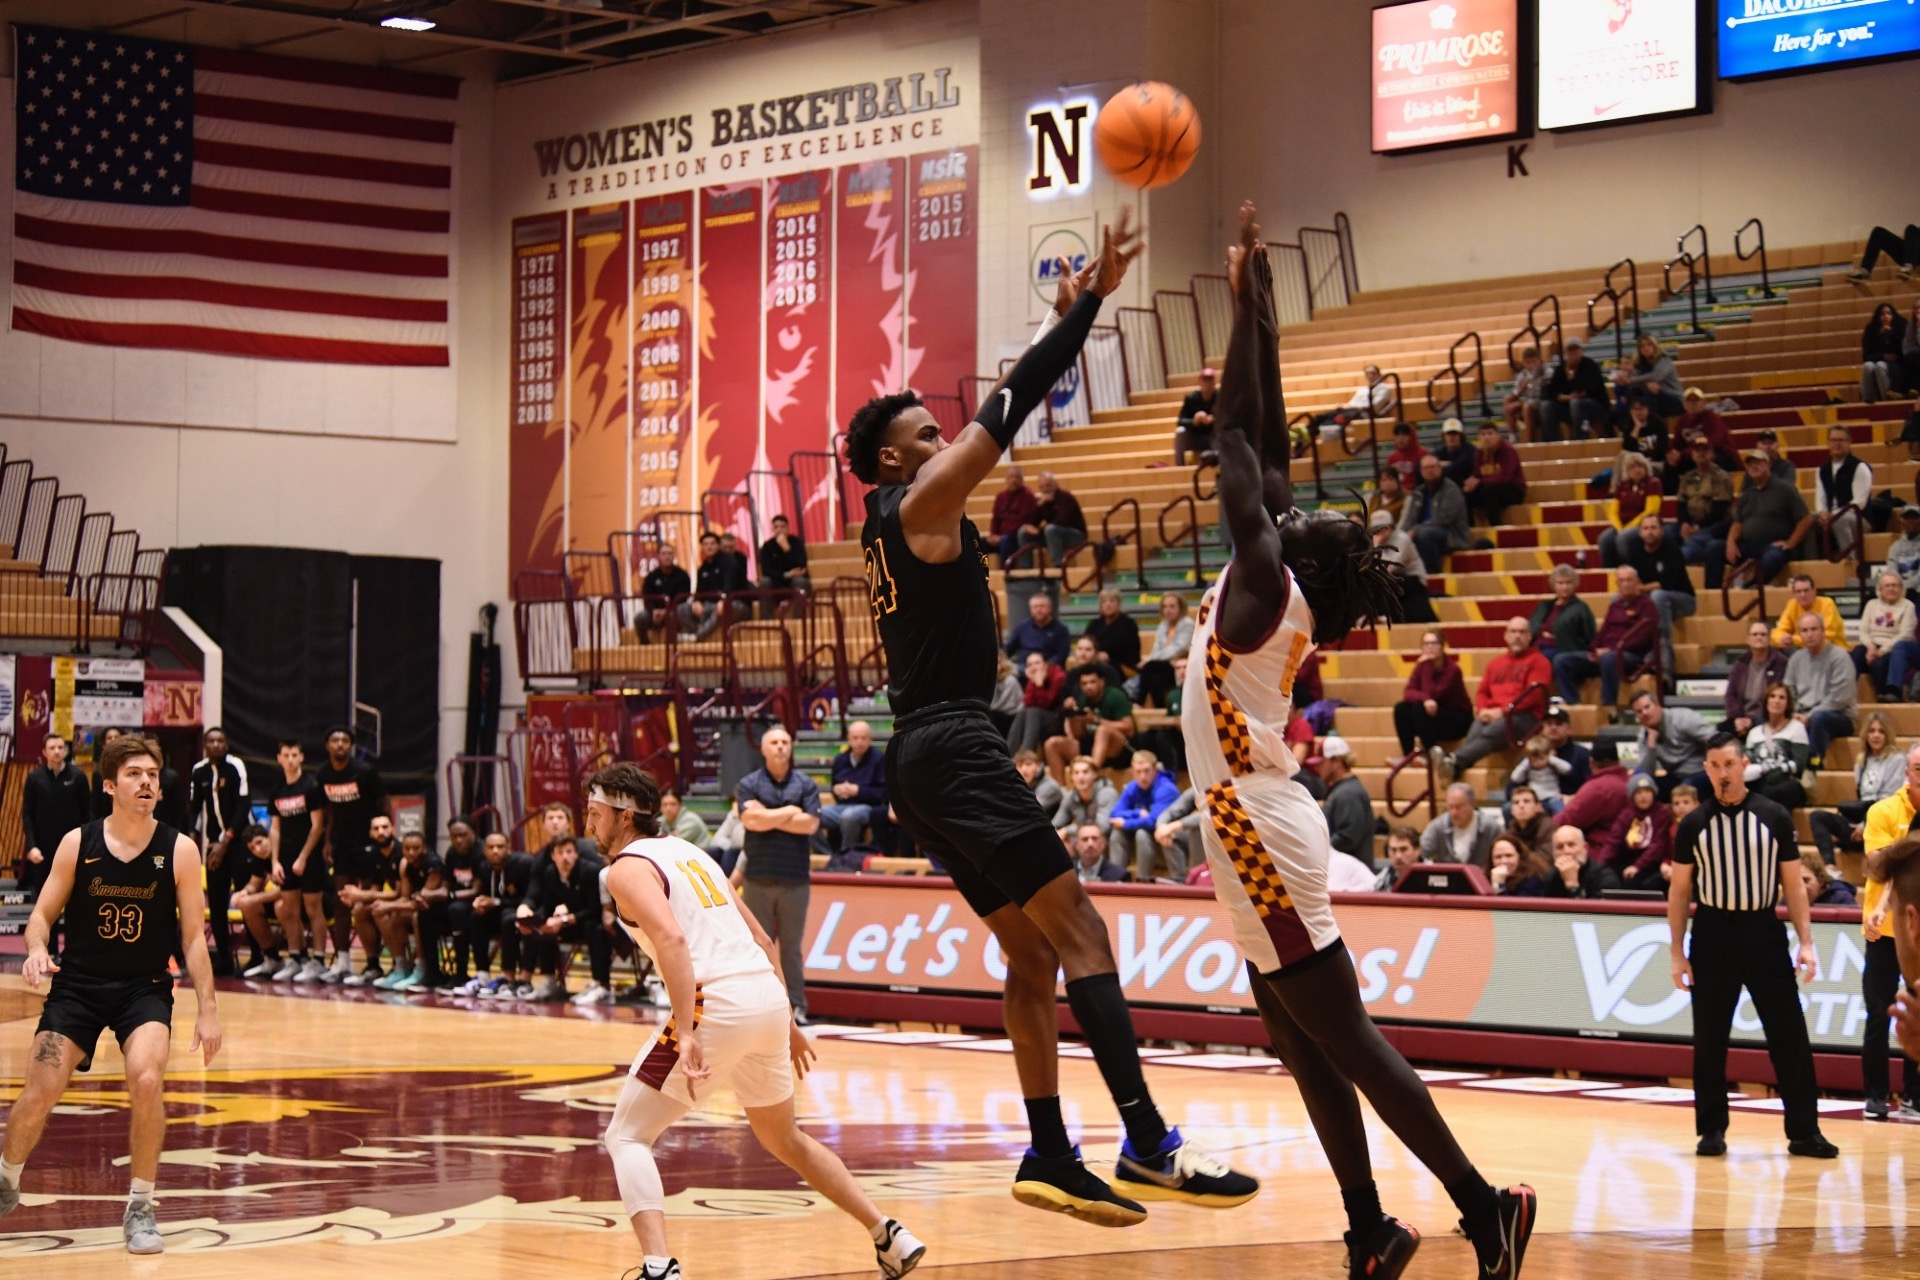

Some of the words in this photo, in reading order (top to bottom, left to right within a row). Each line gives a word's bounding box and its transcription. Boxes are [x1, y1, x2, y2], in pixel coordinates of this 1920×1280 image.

[1773, 34, 1811, 52] Here
[1808, 28, 1836, 52] for
[1378, 30, 1505, 74] PRIMROSE
[534, 113, 694, 178] WOMEN'S
[711, 67, 960, 148] BASKETBALL
[1030, 104, 1088, 190] N
[547, 183, 558, 200] A
[568, 157, 706, 196] TRADITION
[721, 150, 750, 170] OF
[764, 118, 943, 163] EXCELLENCE
[1507, 143, 1529, 178] K
[920, 193, 962, 218] 2015
[776, 214, 816, 239] 2014
[919, 217, 962, 241] 2017
[642, 238, 679, 262] 1997
[776, 237, 816, 261] 2015
[520, 255, 555, 276] 1977
[776, 260, 816, 283] 2016
[1038, 254, 1086, 279] NSC
[520, 276, 556, 297] 1988
[642, 274, 680, 296] 1998
[775, 283, 816, 307] 2018
[520, 297, 555, 319] 1992
[520, 319, 554, 340] 1994
[641, 309, 680, 332] 2000
[519, 340, 554, 361] 1995
[641, 344, 680, 367] 2006
[519, 361, 554, 382] 1997
[518, 382, 554, 403] 1998
[640, 379, 678, 402] 2011
[517, 404, 554, 425] 2018
[640, 414, 679, 436] 2014
[640, 450, 679, 472] 2015
[640, 485, 679, 507] 2016
[165, 685, 200, 723] N
[88, 877, 158, 899] Emmanuel
[675, 859, 728, 908] 11
[97, 902, 143, 943] 33
[804, 901, 968, 977] Let's
